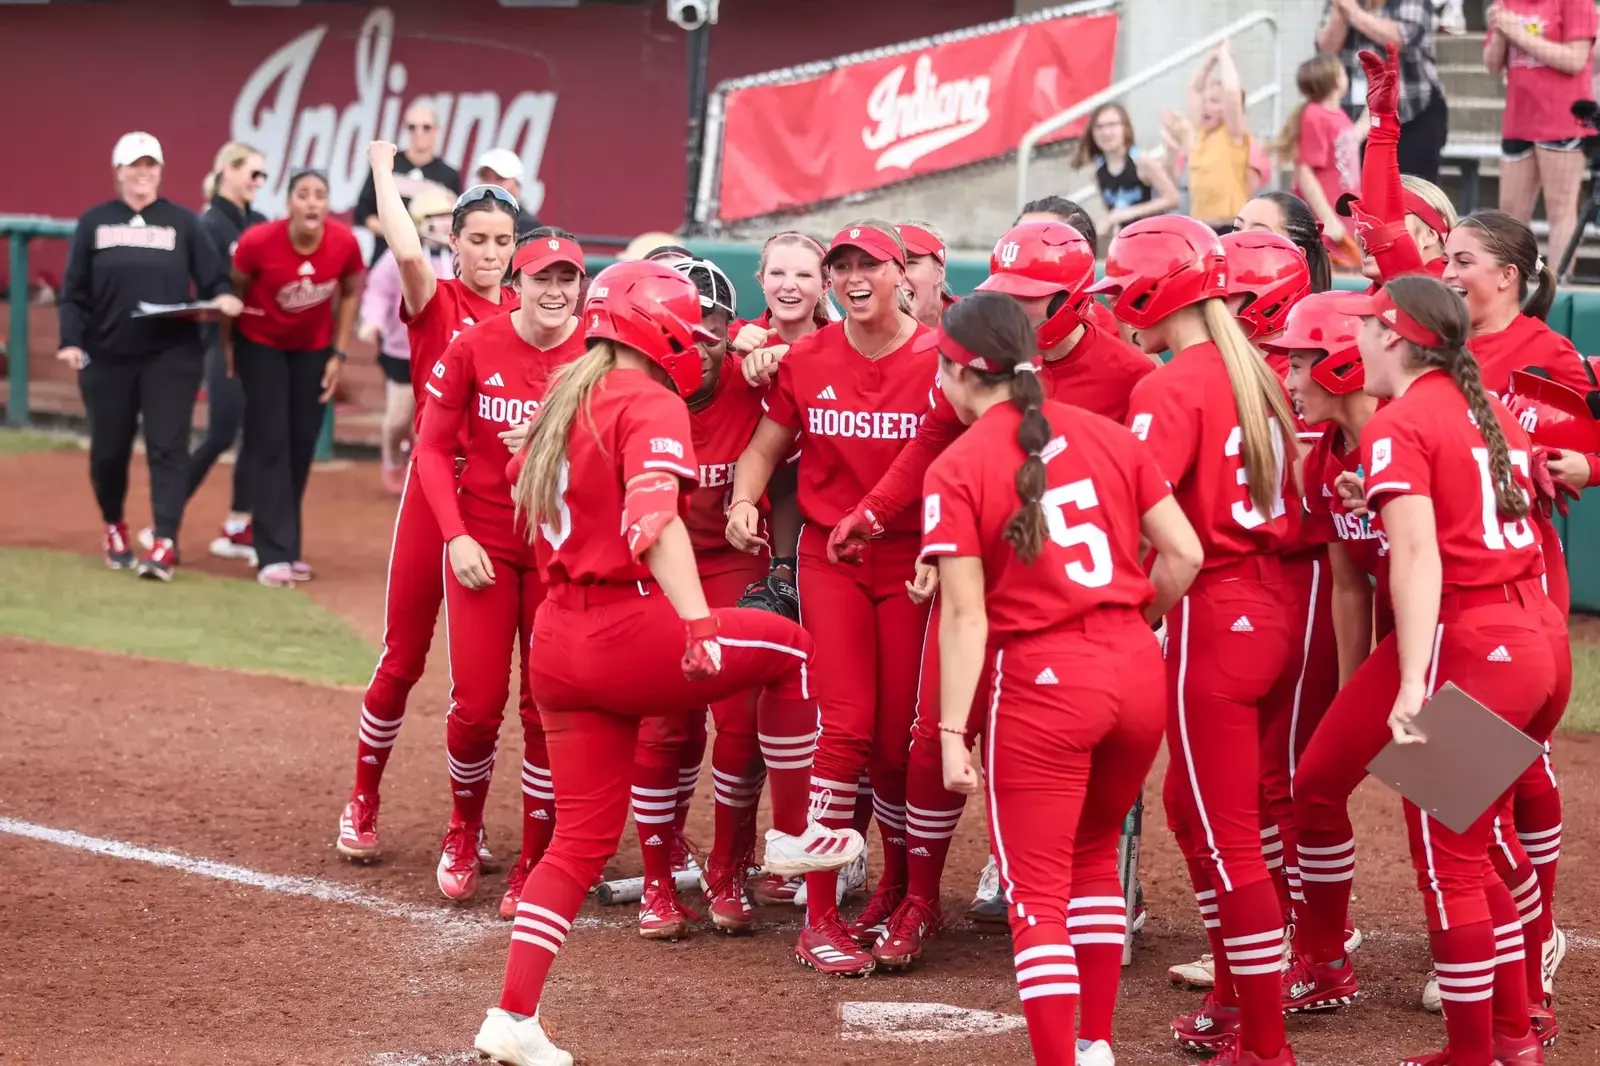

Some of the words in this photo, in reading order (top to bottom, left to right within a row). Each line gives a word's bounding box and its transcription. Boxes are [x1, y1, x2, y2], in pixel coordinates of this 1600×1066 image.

[861, 53, 991, 171] Indiana
[808, 407, 926, 439] HOOSIER
[1041, 477, 1114, 588] 5
